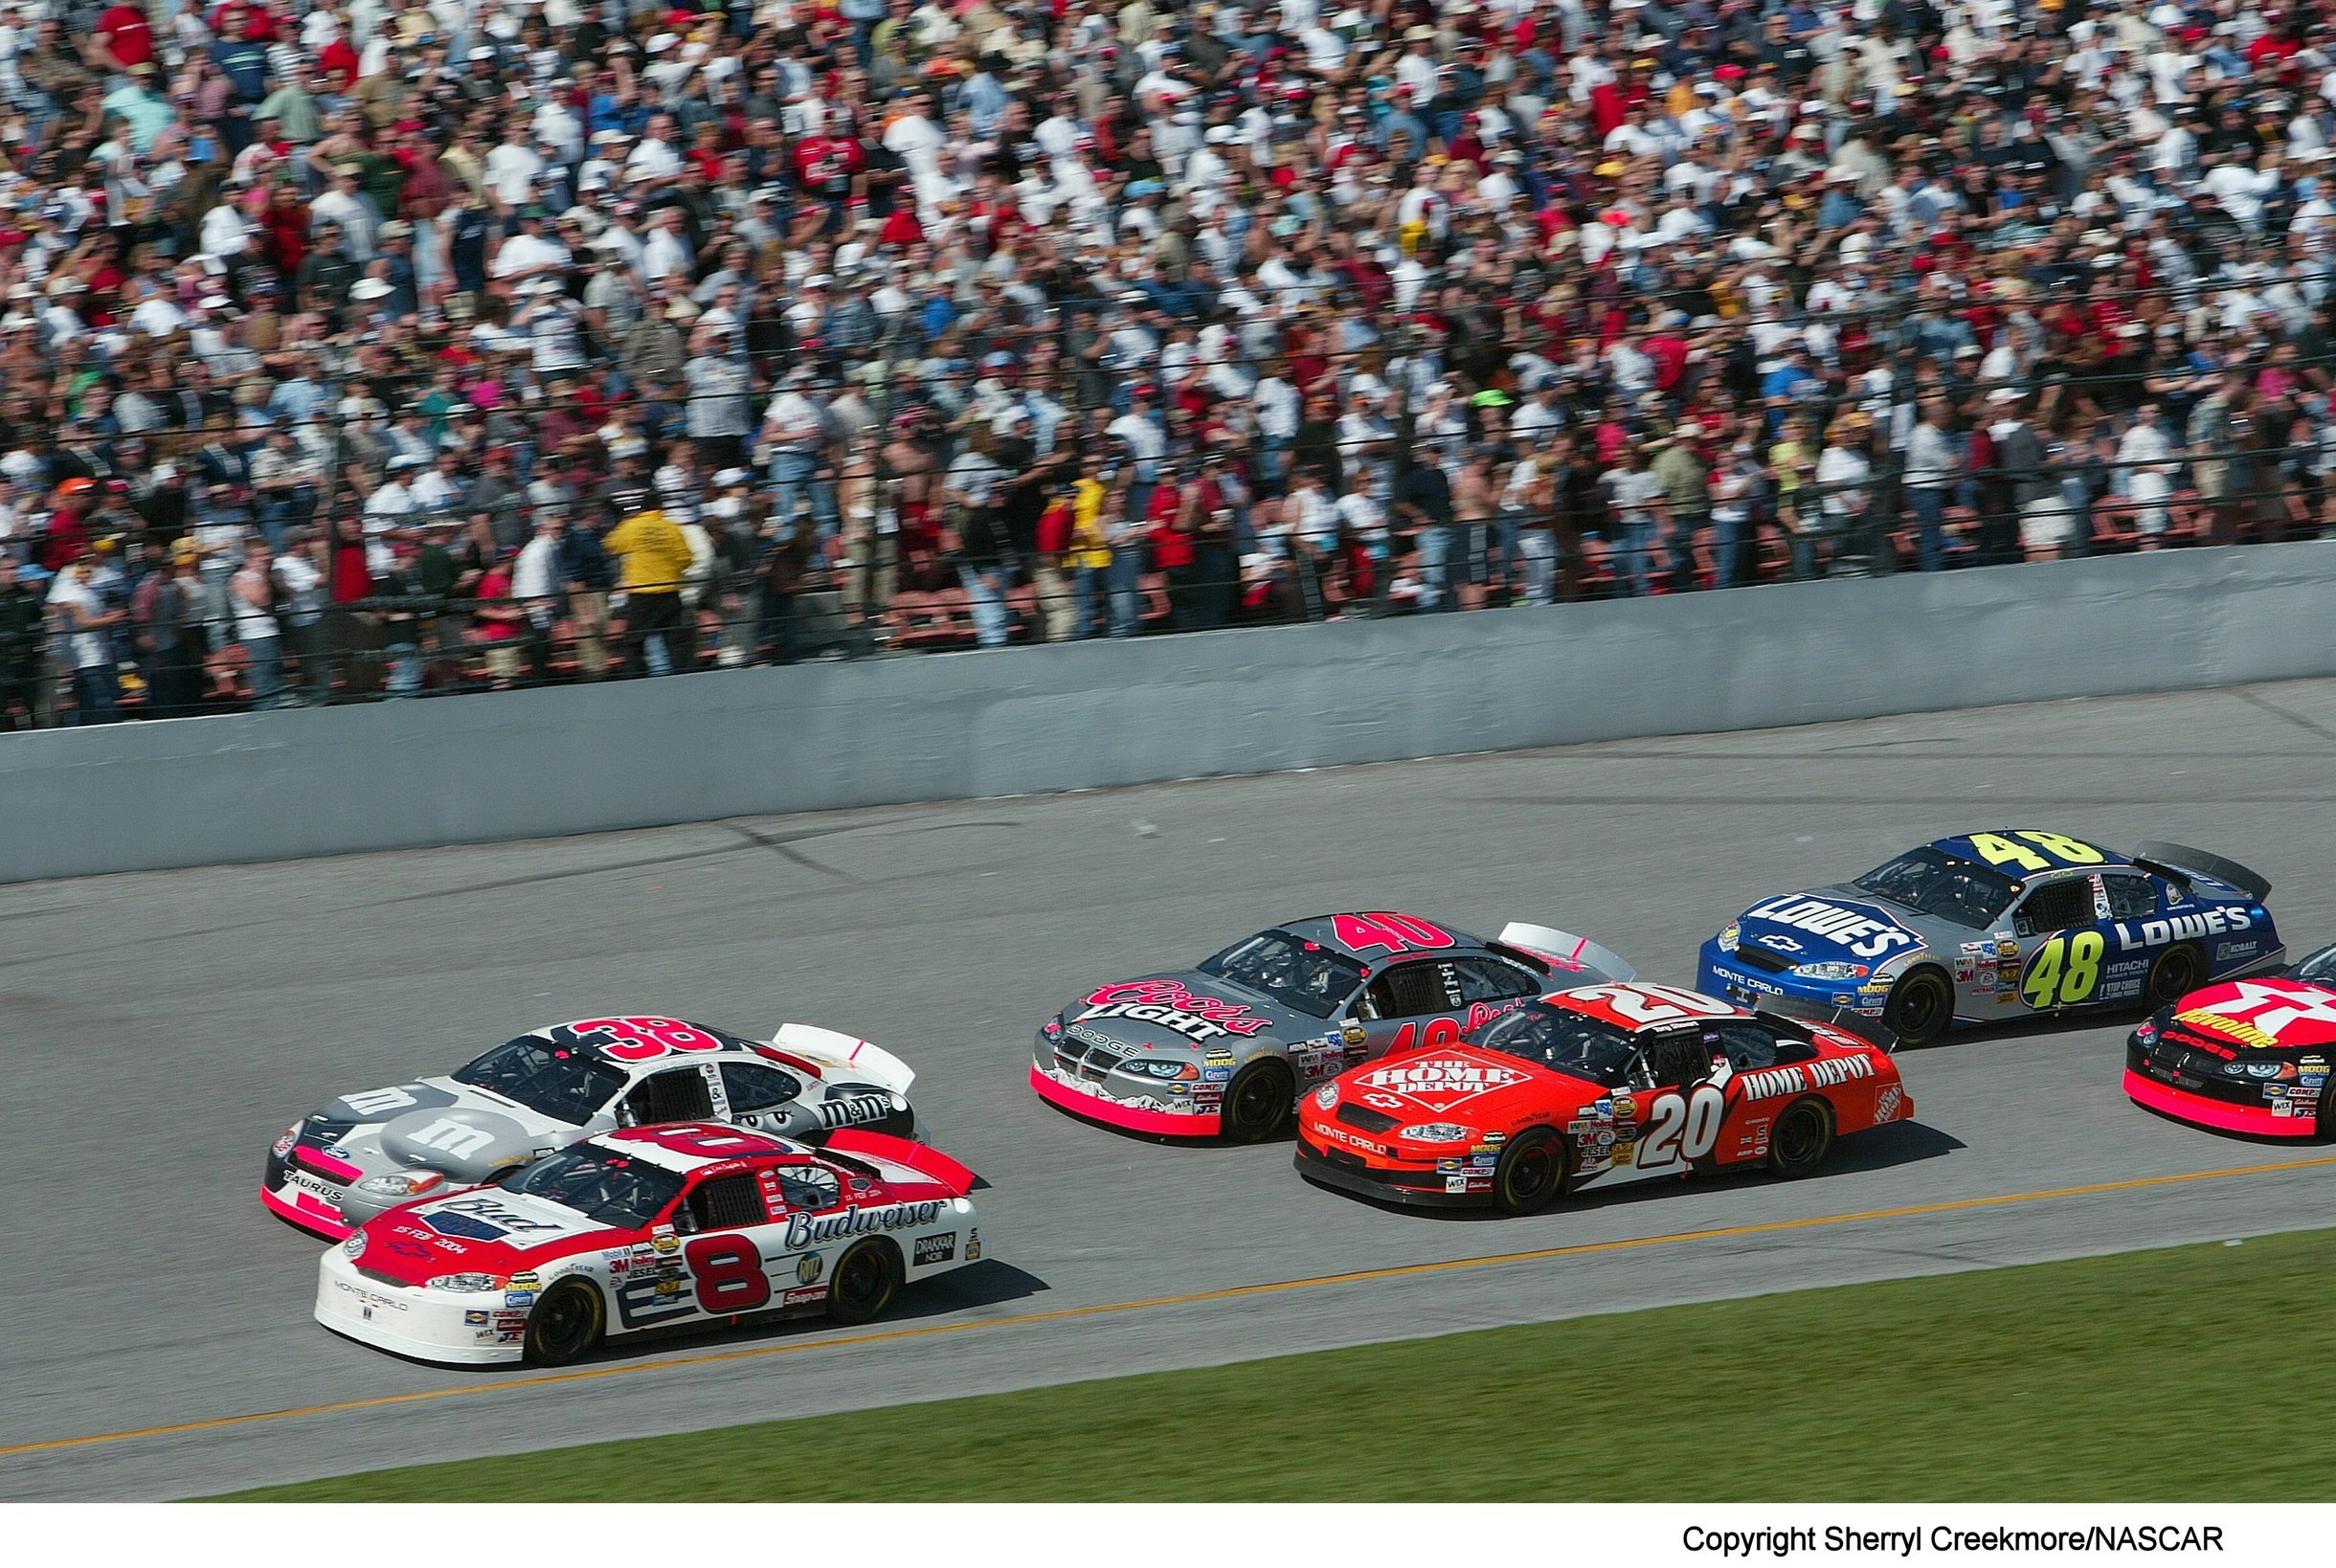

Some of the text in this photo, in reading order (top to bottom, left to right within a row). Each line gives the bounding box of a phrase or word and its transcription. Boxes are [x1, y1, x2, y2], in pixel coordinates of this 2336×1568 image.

[1968, 830, 2105, 871] 48
[1331, 912, 1455, 952] 40
[1748, 895, 1911, 957] LOWE'S
[2114, 907, 2251, 951] LOWE'S
[2230, 941, 2257, 951] KOBALT
[1713, 965, 1784, 996] MONTE CARLO
[1956, 970, 1973, 982] 3M
[2023, 930, 2104, 1010] 48
[2107, 958, 2149, 974] HITACHI
[1569, 981, 1736, 1022] 20
[1857, 984, 1890, 994] MOOG
[1067, 1003, 1228, 1042] LIGHT
[1086, 980, 1273, 1036] Coors
[572, 1017, 722, 1062] 38
[1066, 1024, 1141, 1057] DODGE
[2170, 1008, 2279, 1048] Havoline
[2161, 1030, 2237, 1061] DODGE
[1202, 1058, 1236, 1066] MOOG
[1306, 1064, 1324, 1078] 3M
[1372, 1067, 1516, 1086] HOME
[1397, 1082, 1492, 1093] DEPOT
[1740, 1053, 1876, 1102] HOME DEPOT
[338, 1086, 417, 1115] m
[1174, 1100, 1191, 1109] WIX
[2274, 1102, 2291, 1110] WIX
[406, 1118, 495, 1160] m
[1314, 1122, 1387, 1154] MONTE CARLO
[1579, 1133, 1597, 1146] 3M
[1638, 1086, 1724, 1169] 20
[1471, 1144, 1501, 1153] MOOG
[1582, 1147, 1611, 1157] JESEL
[283, 1170, 343, 1201] TAURUS
[1448, 1178, 1465, 1188] WIX
[438, 1198, 564, 1232] Bud
[785, 1198, 947, 1250] Budweiser
[407, 1227, 434, 1241] FEB
[434, 1238, 467, 1255] 2004
[916, 1234, 955, 1254] DRAKKAR
[609, 1259, 630, 1274] 3M
[799, 1258, 820, 1279] RITZ
[925, 1251, 944, 1262] NOIR
[627, 1267, 656, 1279] JESEL
[685, 1233, 771, 1315] 8
[335, 1280, 408, 1311] MONTE CARLO
[785, 1289, 828, 1305] Snap-on
